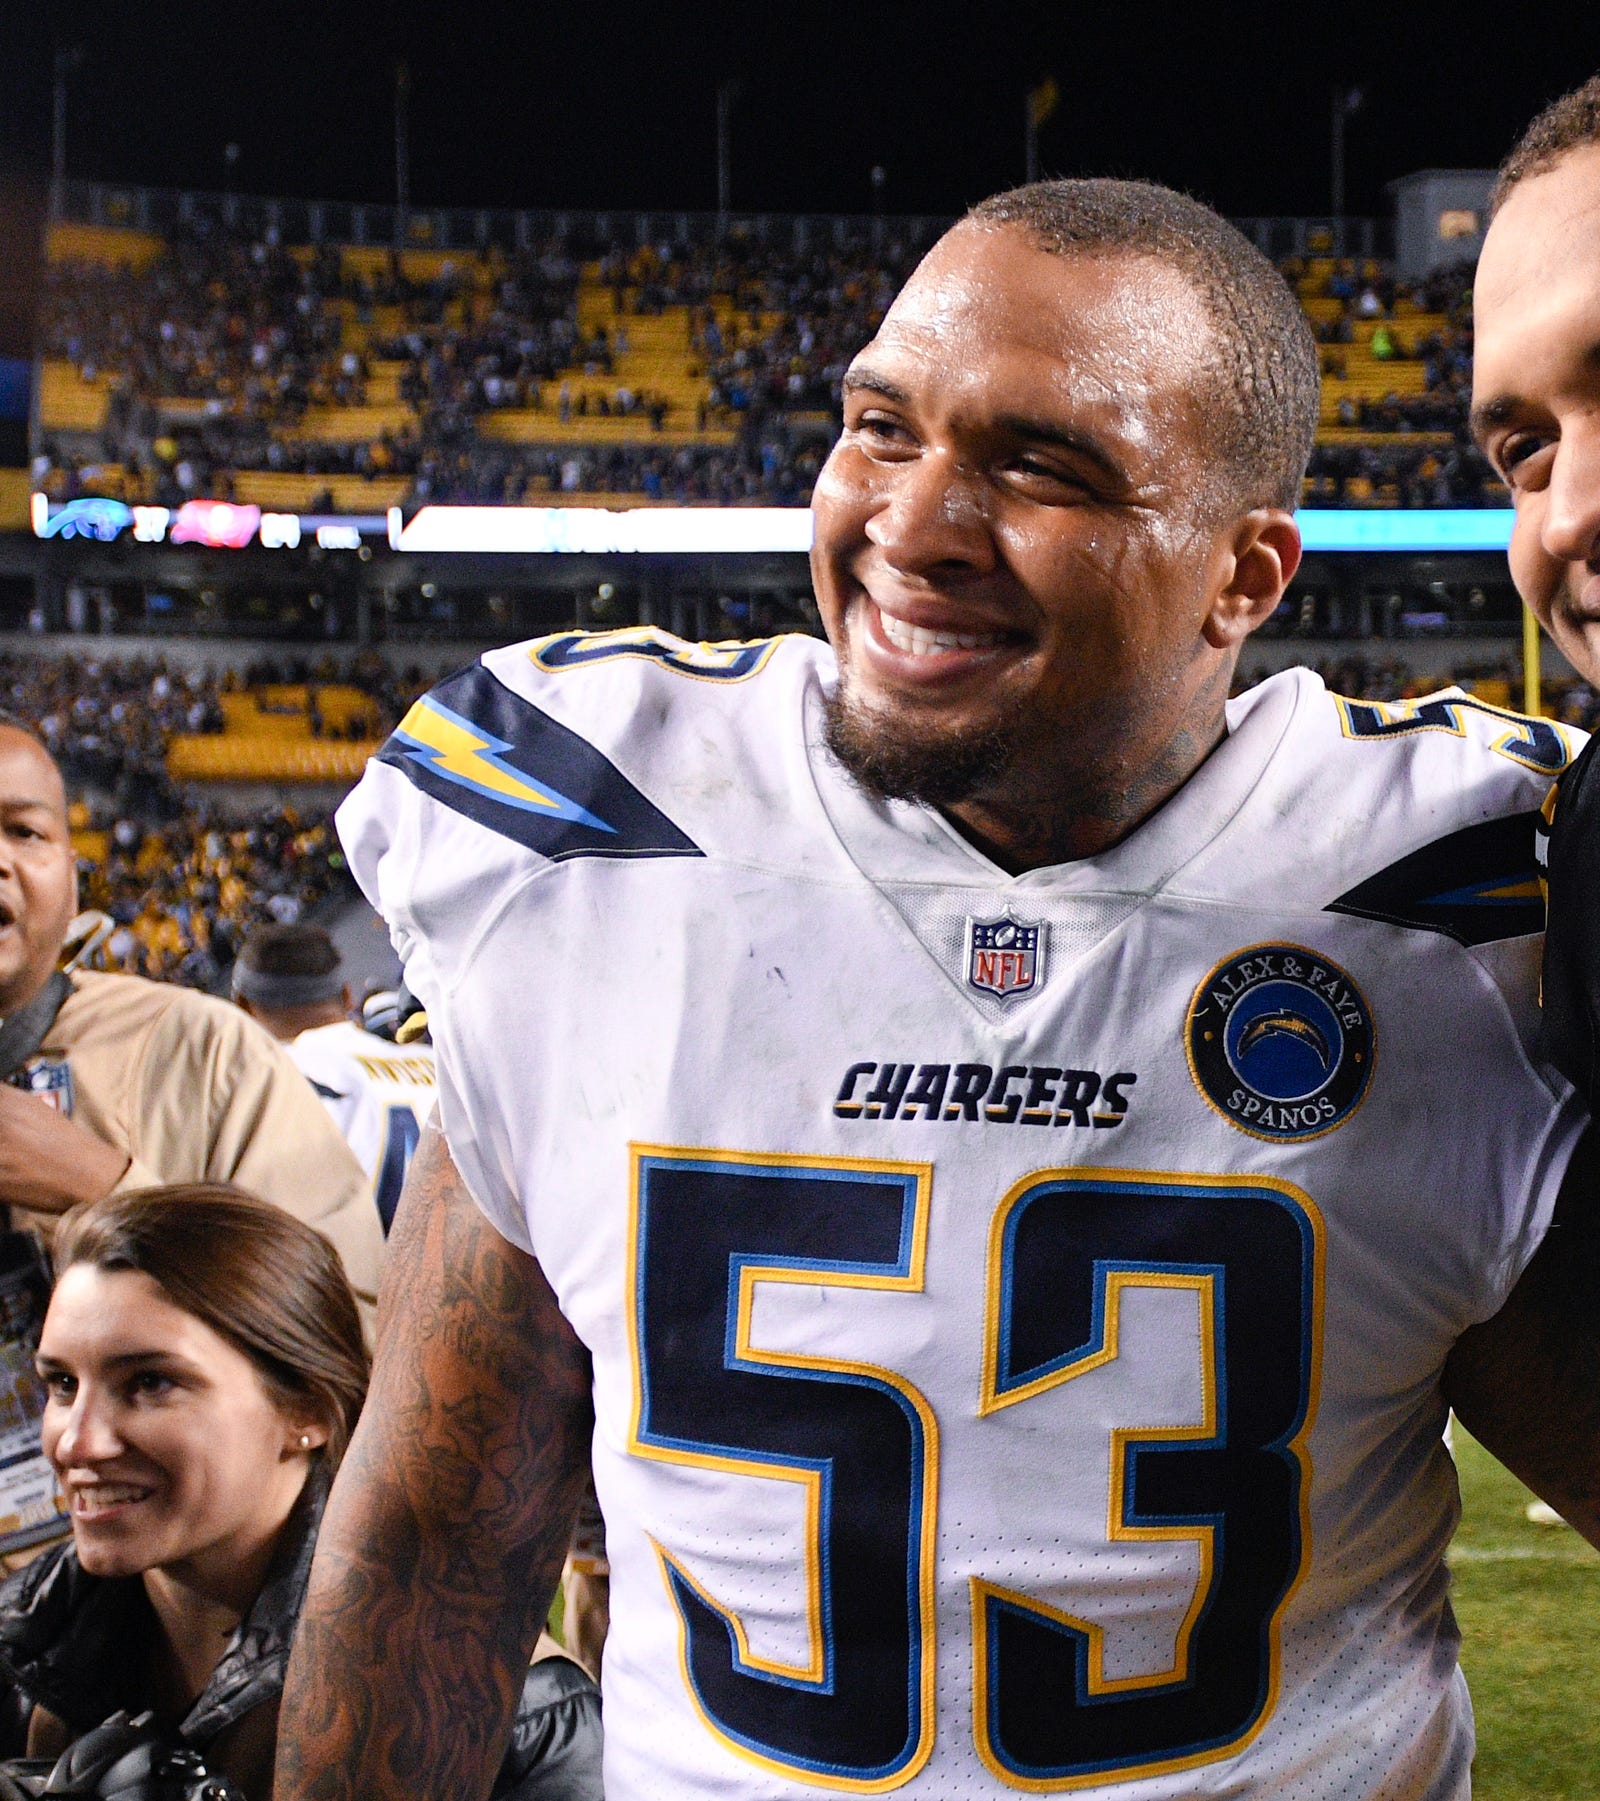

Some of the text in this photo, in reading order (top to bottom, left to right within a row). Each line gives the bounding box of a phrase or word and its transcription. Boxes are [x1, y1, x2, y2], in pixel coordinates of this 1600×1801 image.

[975, 951, 1031, 990] NFL
[1212, 956, 1363, 1030] ALEX & FAYE
[832, 1061, 1138, 1129] CHARGERS
[1226, 1089, 1337, 1129] SPANOS
[626, 1141, 1326, 1794] 53
